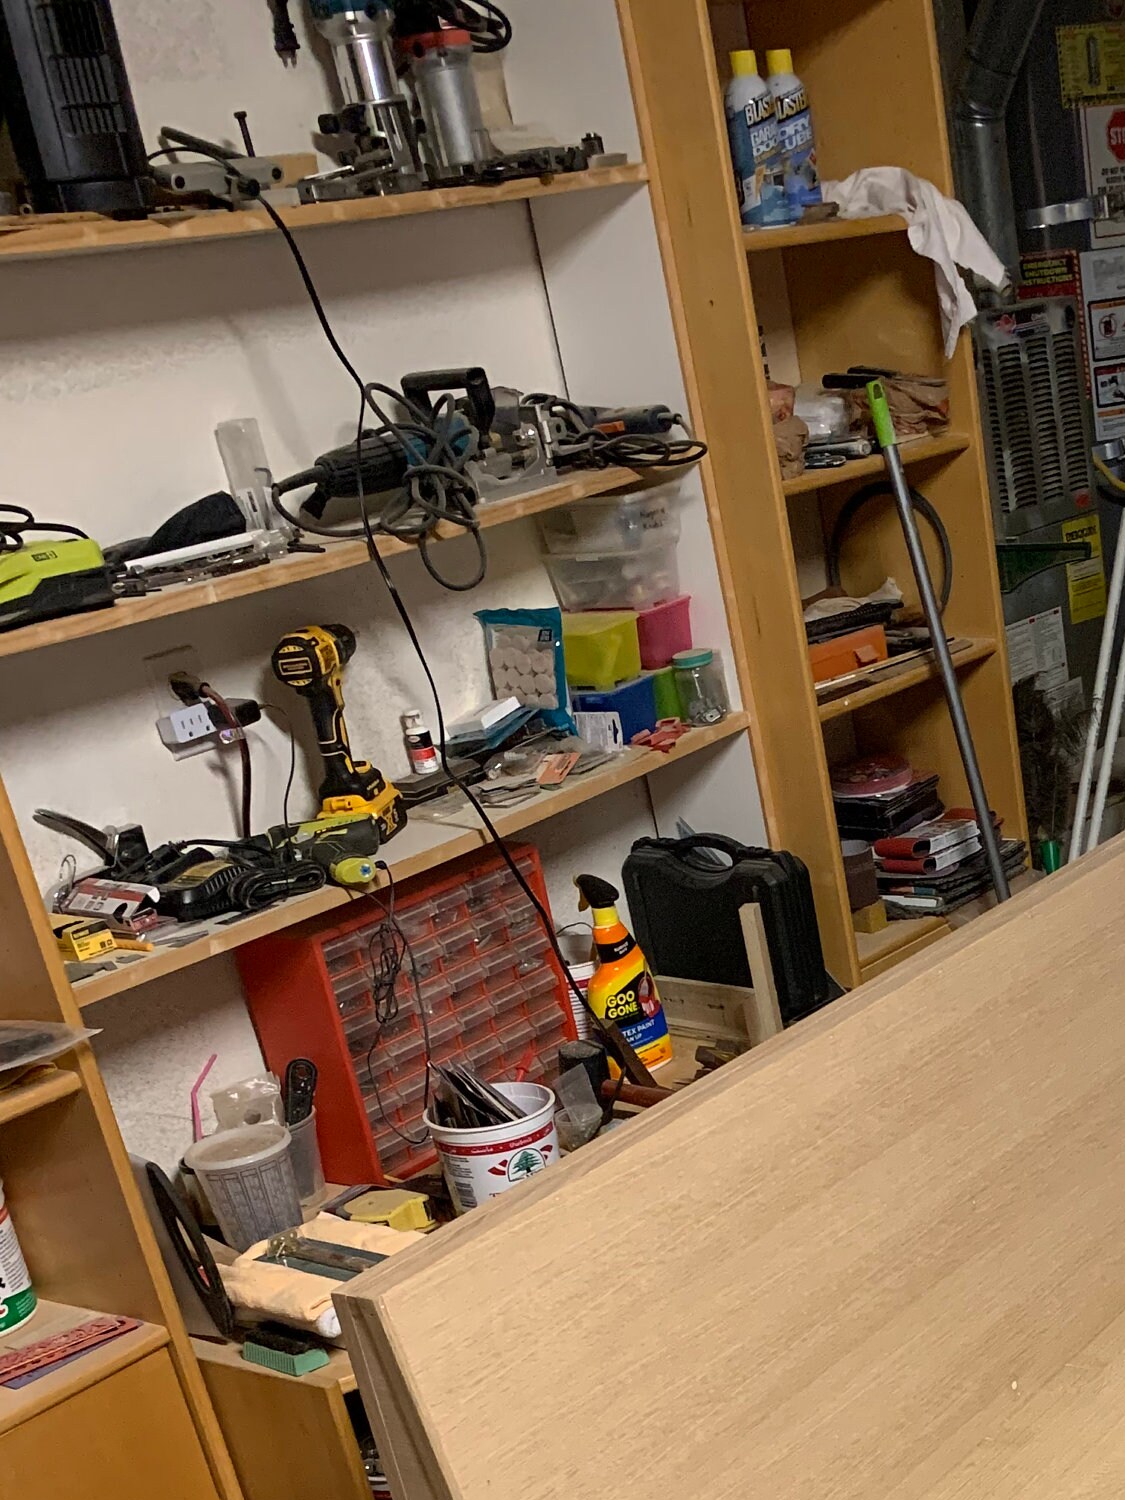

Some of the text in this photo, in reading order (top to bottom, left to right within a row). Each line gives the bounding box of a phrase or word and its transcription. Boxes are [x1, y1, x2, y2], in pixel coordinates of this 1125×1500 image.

[745, 94, 774, 126] BLAS
[777, 90, 808, 120] LASTE
[751, 121, 777, 147] GARA
[779, 114, 811, 140] DRY
[782, 127, 813, 152] UBE
[753, 136, 778, 157] DOO
[607, 990, 635, 1008] GOO
[608, 1002, 638, 1019] GONE
[621, 1019, 655, 1038] TEX PAINT
